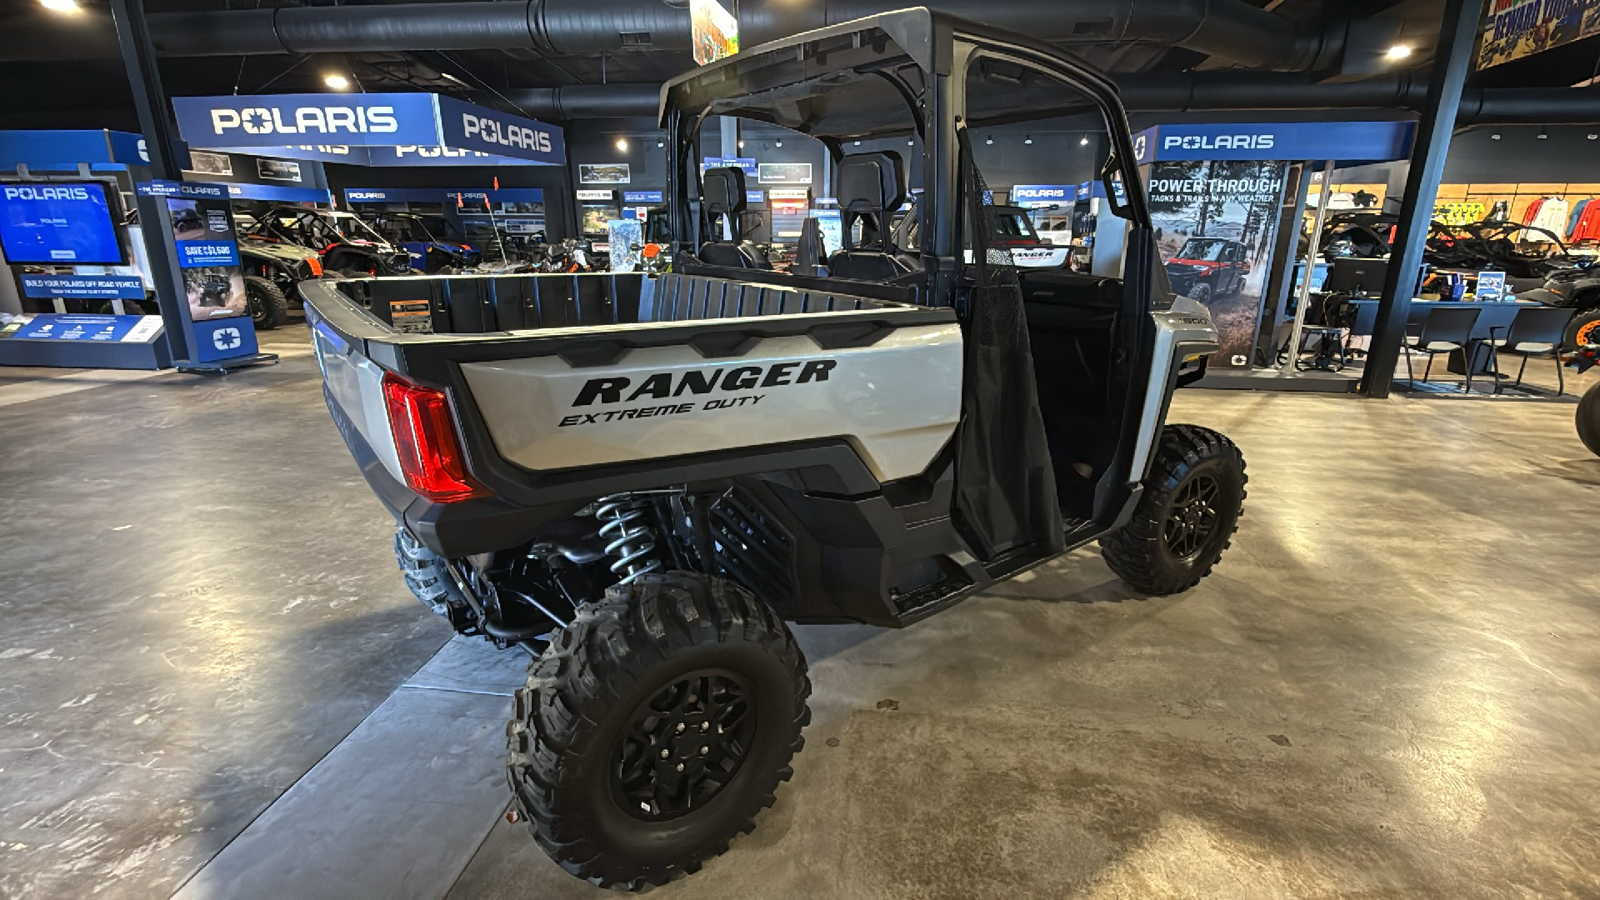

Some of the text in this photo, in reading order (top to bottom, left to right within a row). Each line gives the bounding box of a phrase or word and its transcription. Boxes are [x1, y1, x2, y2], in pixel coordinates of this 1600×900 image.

[1493, 0, 1542, 40] REWARD
[211, 106, 398, 135] POLARIS
[462, 112, 552, 153] POLARIS
[1164, 134, 1274, 150] POLARIS
[5, 187, 88, 200] POLARIS
[181, 186, 220, 196] OLARIS
[1017, 189, 1064, 198] POLARIS
[1148, 179, 1281, 193] POWER THROUGH
[184, 246, 203, 255] SAVE
[571, 359, 837, 407] RANGER
[558, 394, 766, 428] EXTREME DUTY
